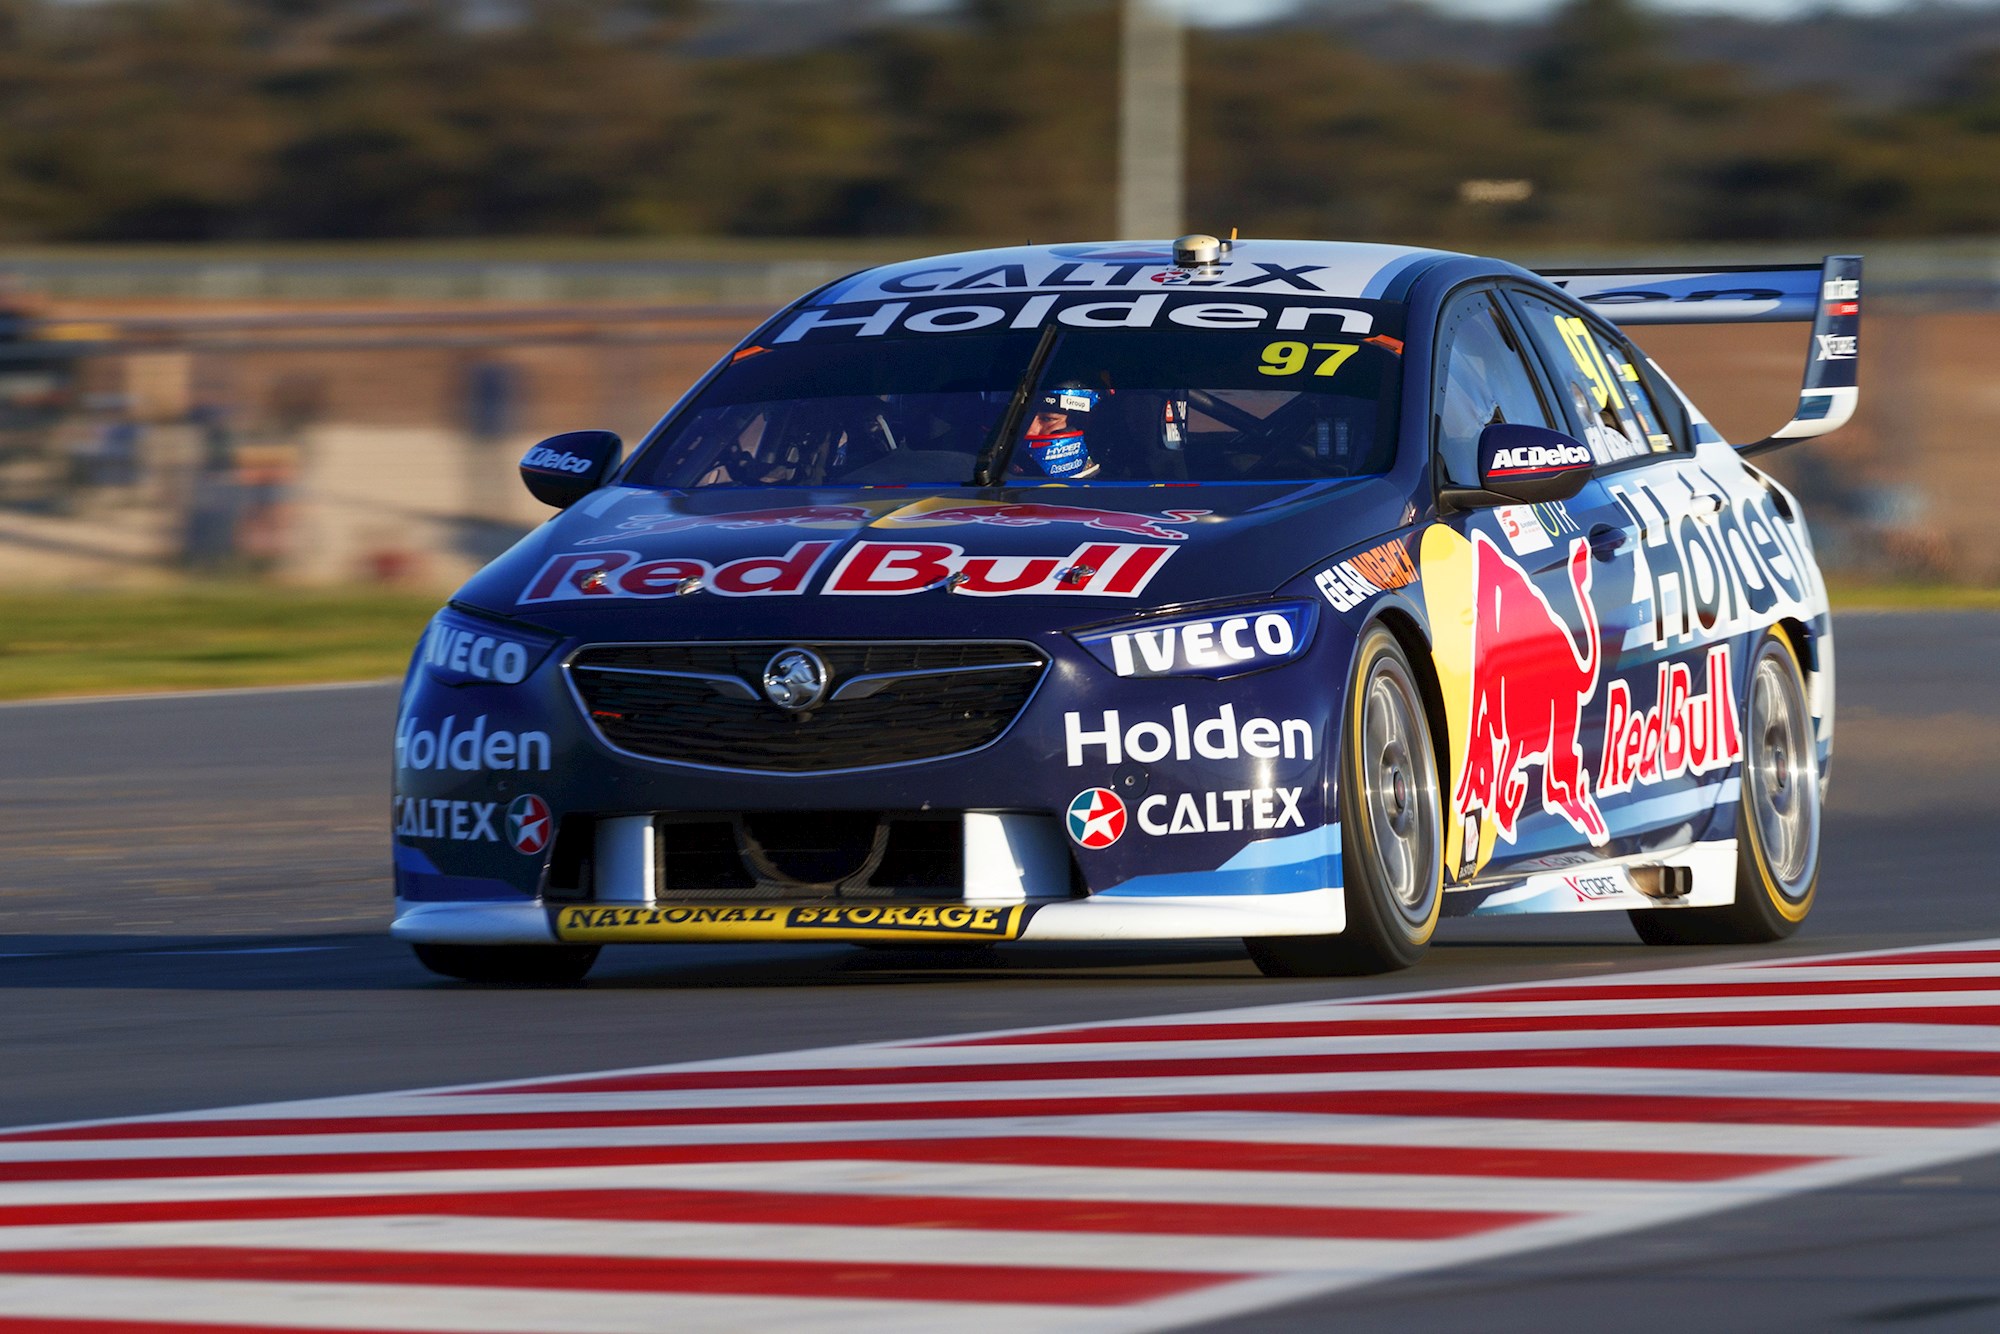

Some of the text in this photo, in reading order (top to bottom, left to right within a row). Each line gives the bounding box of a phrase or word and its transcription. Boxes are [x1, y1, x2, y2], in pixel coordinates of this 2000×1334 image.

[879, 263, 1331, 293] CALTEX
[1553, 281, 1785, 305] en
[772, 294, 1373, 344] Holden
[1258, 341, 1359, 377] 97
[1554, 315, 1624, 409] 97
[520, 447, 593, 474] Delco
[1046, 442, 1081, 455] HYPER
[1491, 444, 1591, 470] ACDelco
[522, 541, 1178, 602] Red Bull
[1315, 538, 1420, 612] GEARWRENCH
[1615, 467, 1816, 642] Holden
[425, 621, 527, 684] IVECO
[1111, 614, 1294, 677] IVECO
[1064, 703, 1314, 767] Holden
[1598, 646, 1742, 794] Red Bull
[1137, 787, 1305, 836] CALTEX
[566, 906, 999, 929] NATIONAL STORAGE
